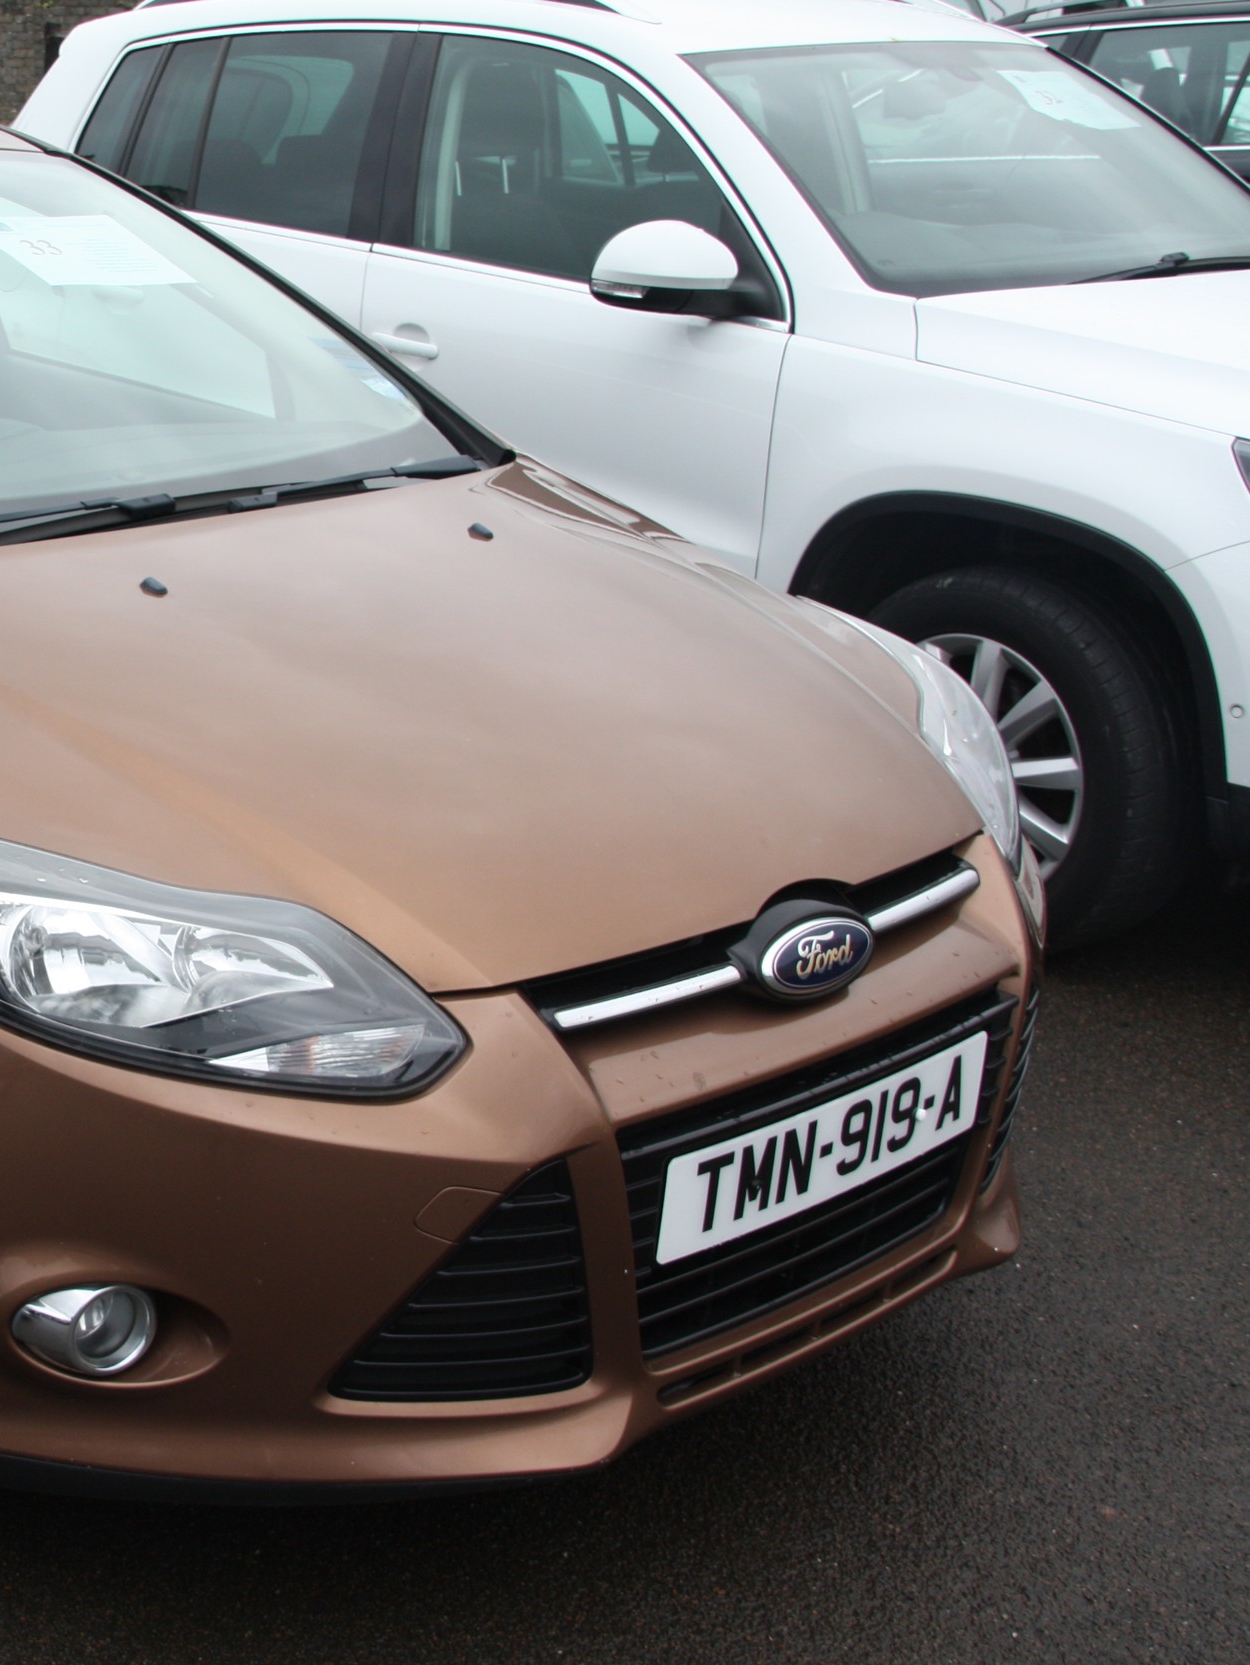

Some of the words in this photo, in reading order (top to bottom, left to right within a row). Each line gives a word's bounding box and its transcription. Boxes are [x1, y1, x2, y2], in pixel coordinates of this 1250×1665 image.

[20, 239, 62, 256] 33
[796, 930, 853, 980] Ford
[697, 1054, 962, 1233] TMN-919-A
